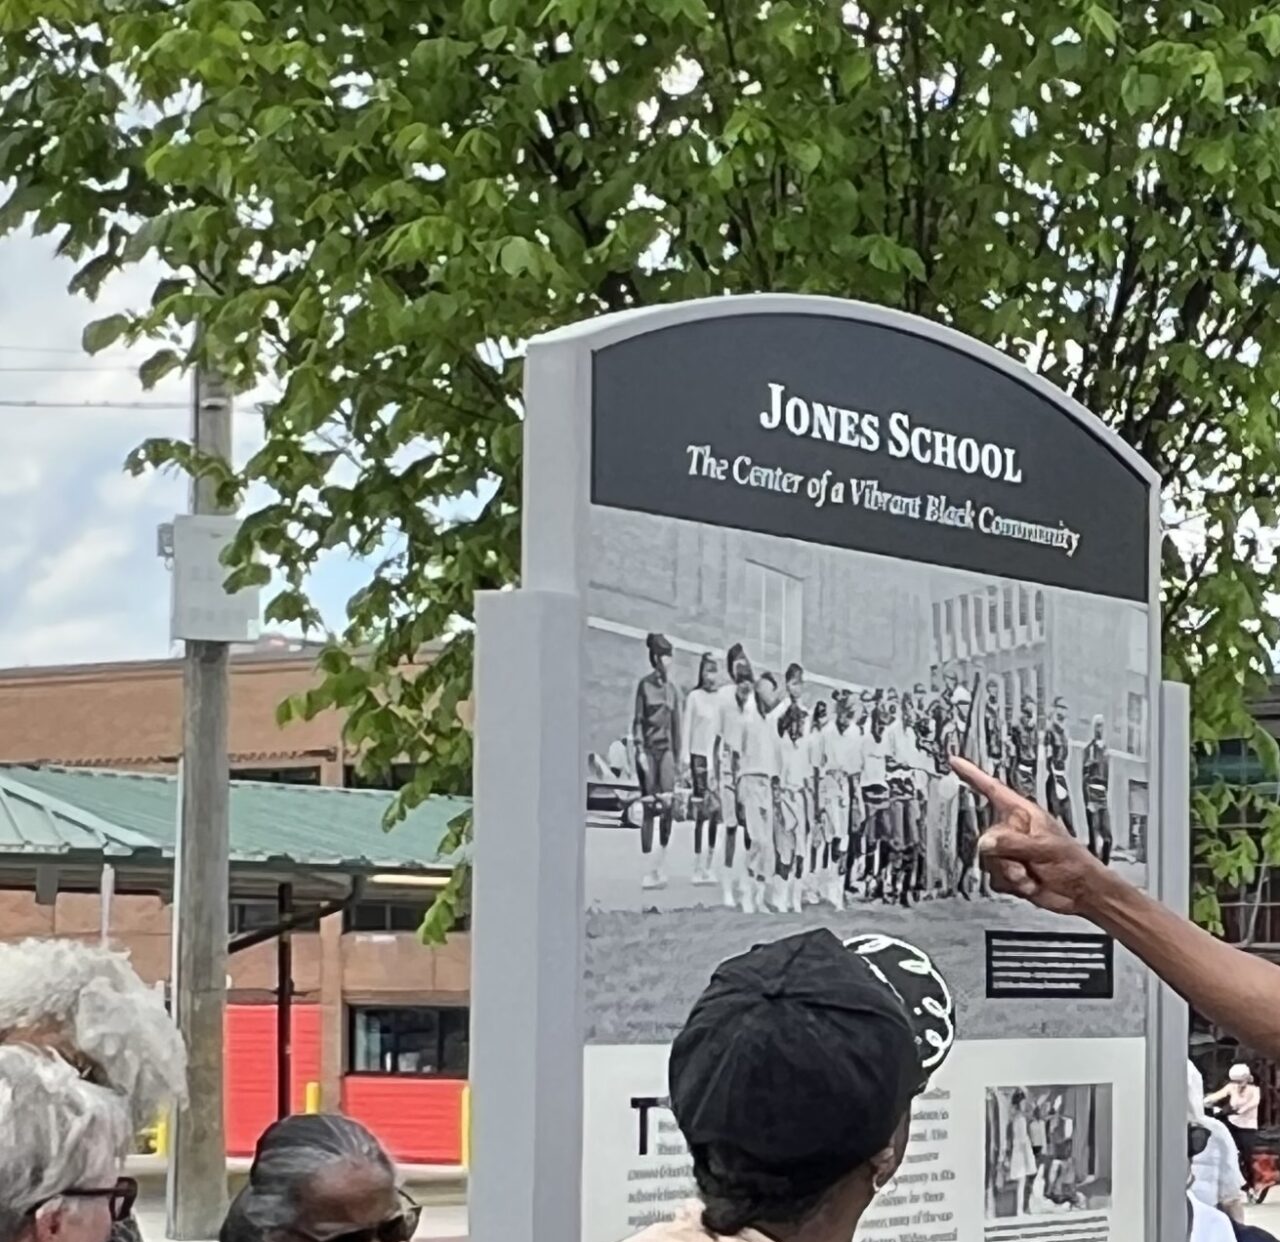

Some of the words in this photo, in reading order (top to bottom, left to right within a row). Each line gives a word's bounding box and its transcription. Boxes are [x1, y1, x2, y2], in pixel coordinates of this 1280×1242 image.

[760, 383, 880, 452] JONES
[888, 412, 1022, 483] SCHOOL
[686, 445, 729, 480] The
[732, 455, 804, 493] Center
[807, 469, 832, 507] of
[831, 482, 844, 504] a
[850, 478, 922, 519] Vibrant
[925, 495, 975, 529] Black
[978, 506, 1081, 558] Community
